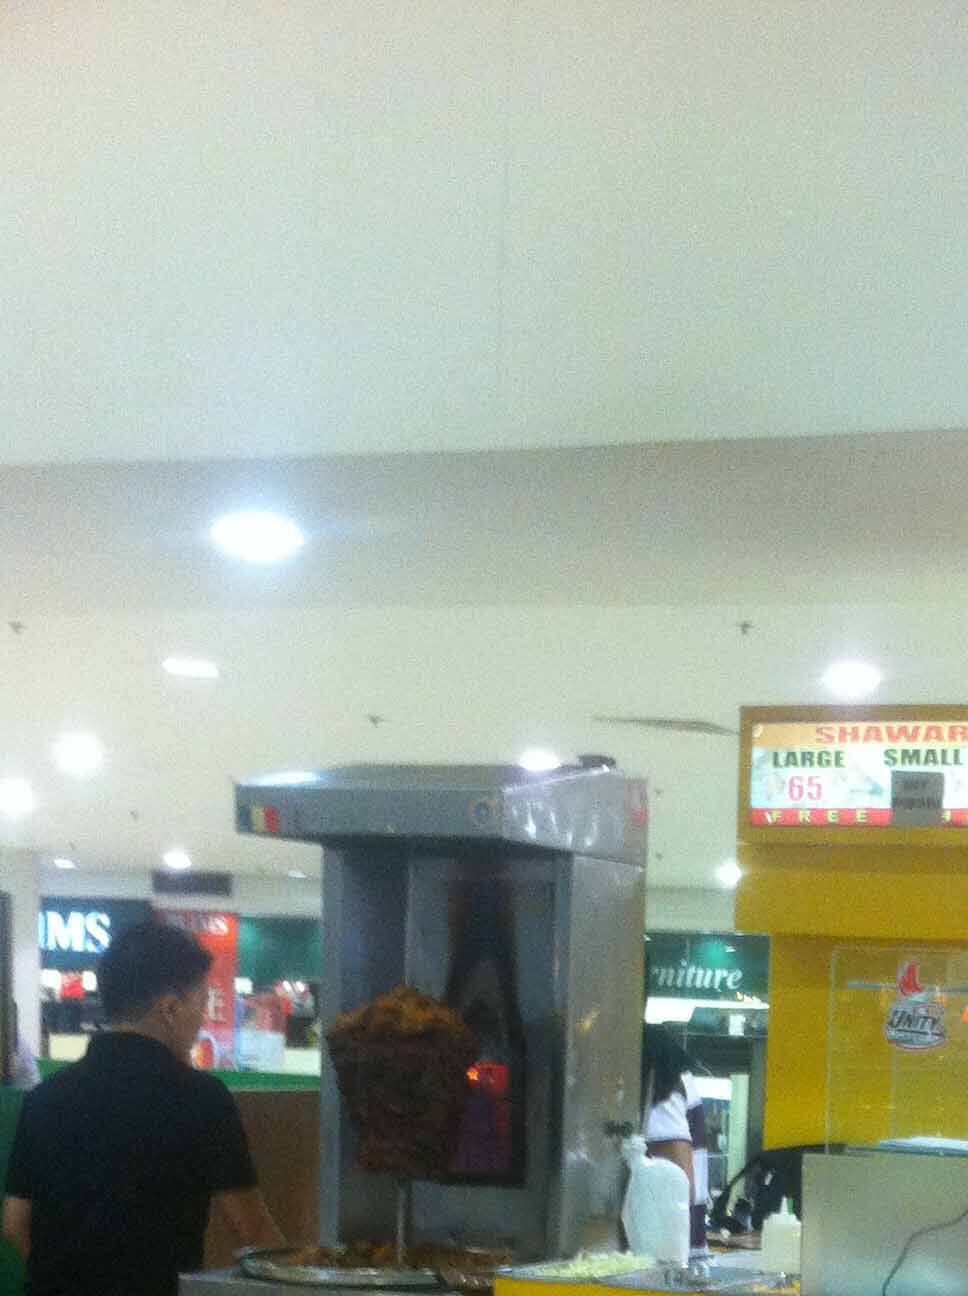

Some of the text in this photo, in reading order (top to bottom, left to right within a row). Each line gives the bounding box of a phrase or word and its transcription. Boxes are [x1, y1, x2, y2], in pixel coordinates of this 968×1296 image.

[772, 751, 845, 769] LARGE
[884, 748, 963, 767] SMALL
[787, 775, 823, 801] 65
